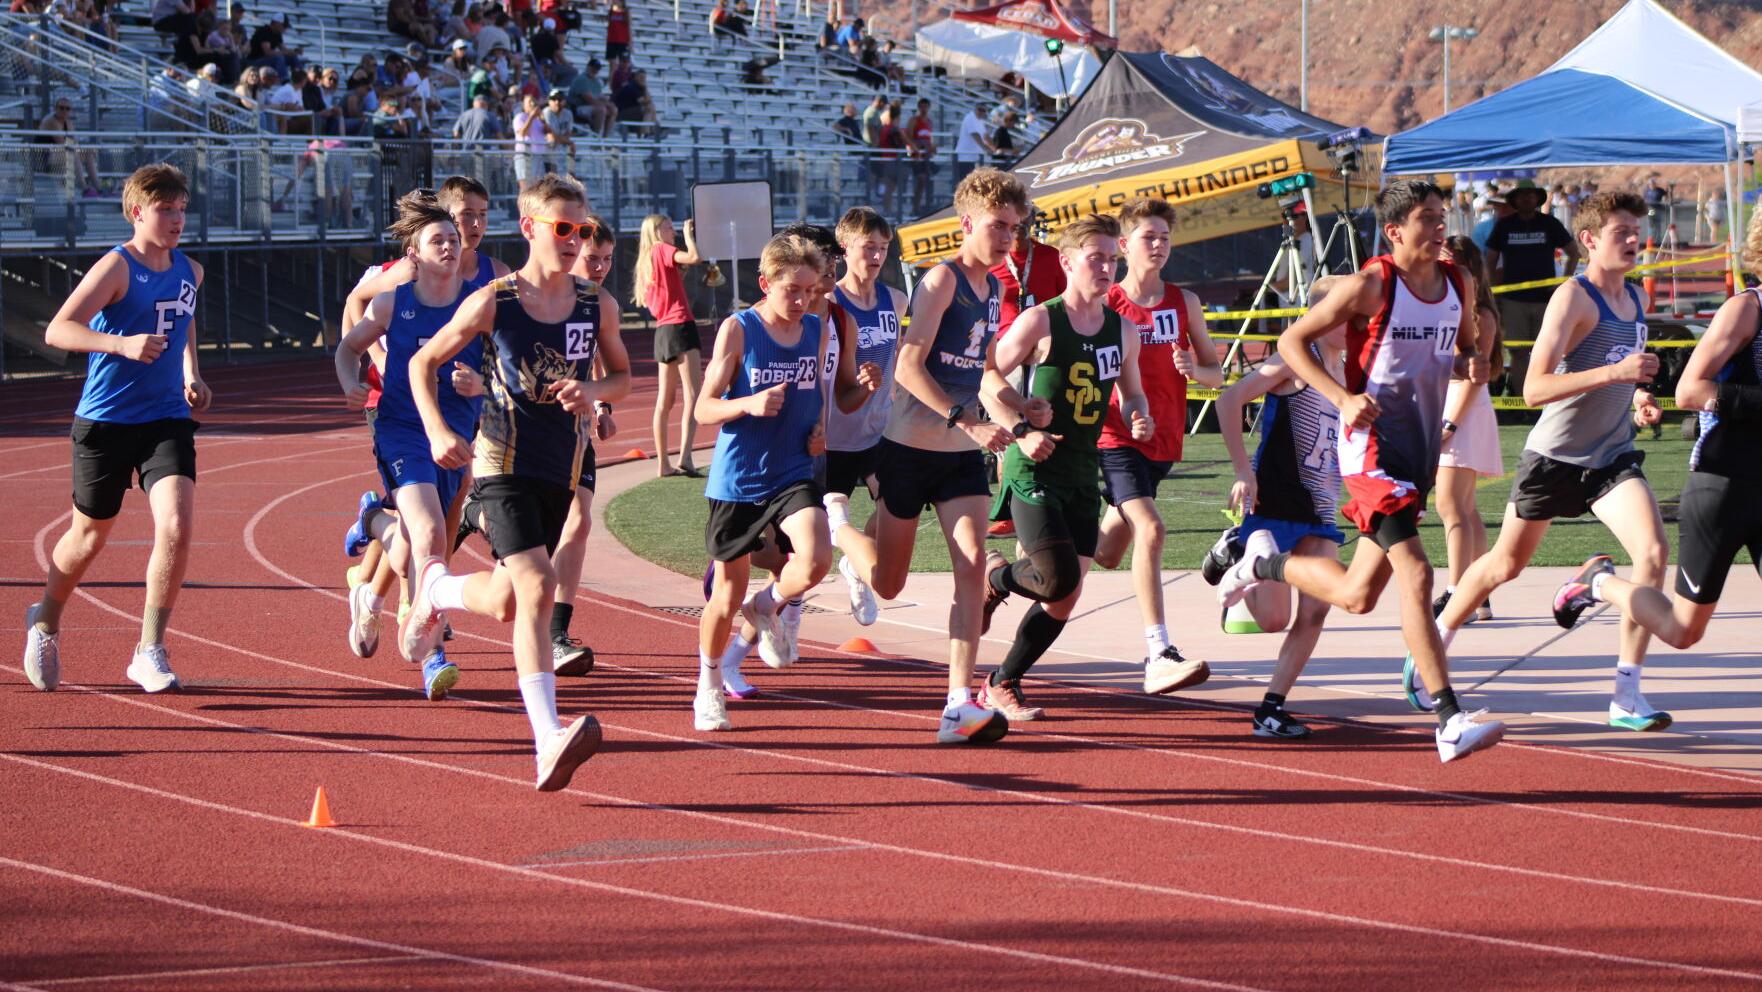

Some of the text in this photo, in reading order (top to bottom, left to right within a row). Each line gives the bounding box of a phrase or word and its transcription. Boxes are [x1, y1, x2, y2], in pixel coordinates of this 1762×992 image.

[1044, 144, 1172, 182] THUNDER
[912, 229, 964, 256] DES
[1135, 156, 1290, 202] THUNDER
[180, 283, 197, 308] 27
[154, 299, 184, 350] F
[880, 313, 896, 334] 16
[1156, 314, 1175, 336] 11
[1391, 326, 1437, 341] MILF
[568, 329, 594, 355] 25
[1440, 326, 1457, 351] 17
[768, 361, 800, 369] PANGUIT
[799, 358, 817, 382] 23
[940, 351, 986, 369] WOLVE
[1099, 350, 1121, 375] 14
[750, 367, 801, 388] BOBCA
[391, 458, 404, 477] F
